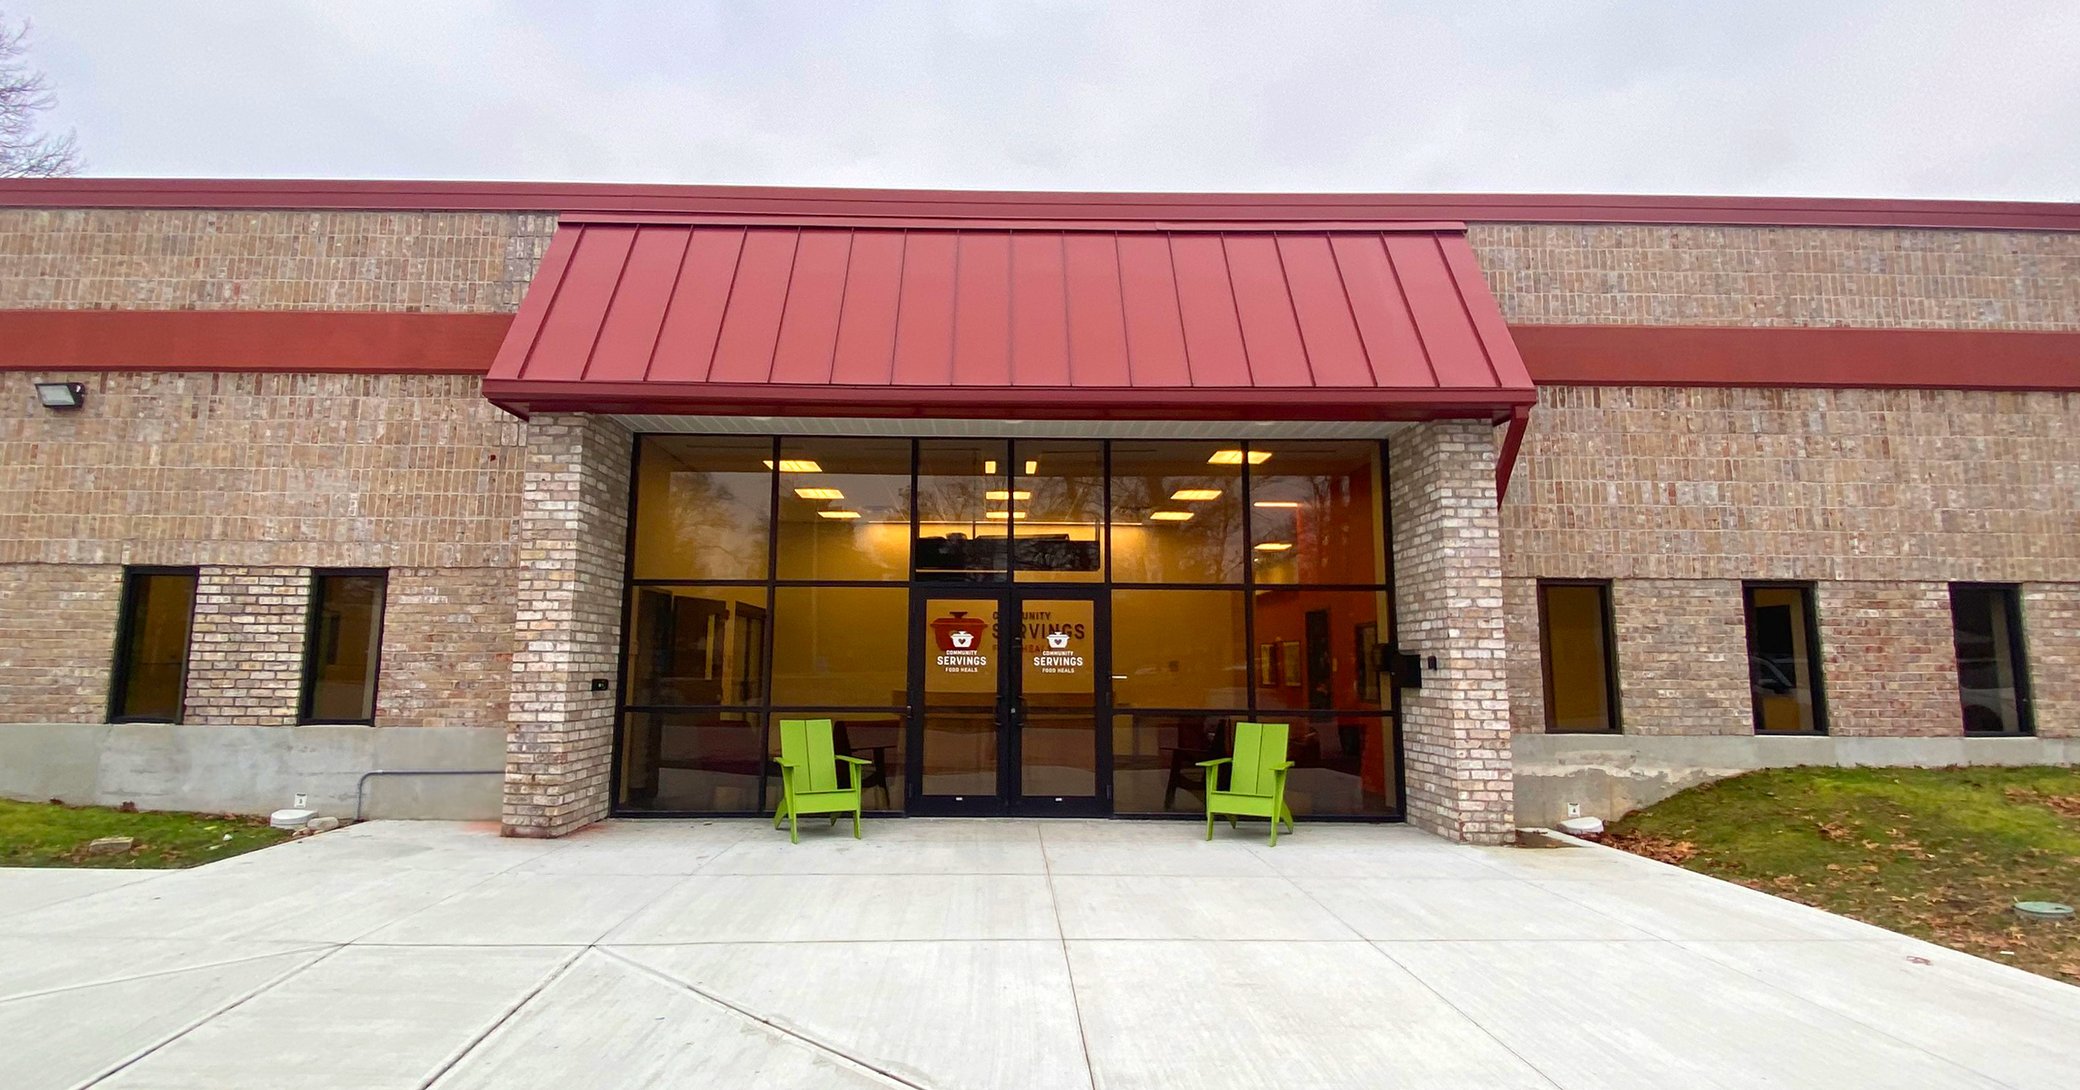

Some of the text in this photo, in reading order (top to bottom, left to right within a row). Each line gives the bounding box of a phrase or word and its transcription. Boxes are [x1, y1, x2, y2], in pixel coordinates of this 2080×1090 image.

[992, 623, 1085, 640] SRVINGS
[937, 656, 987, 666] SERVINGS
[1033, 656, 1083, 666] SERVINGS
